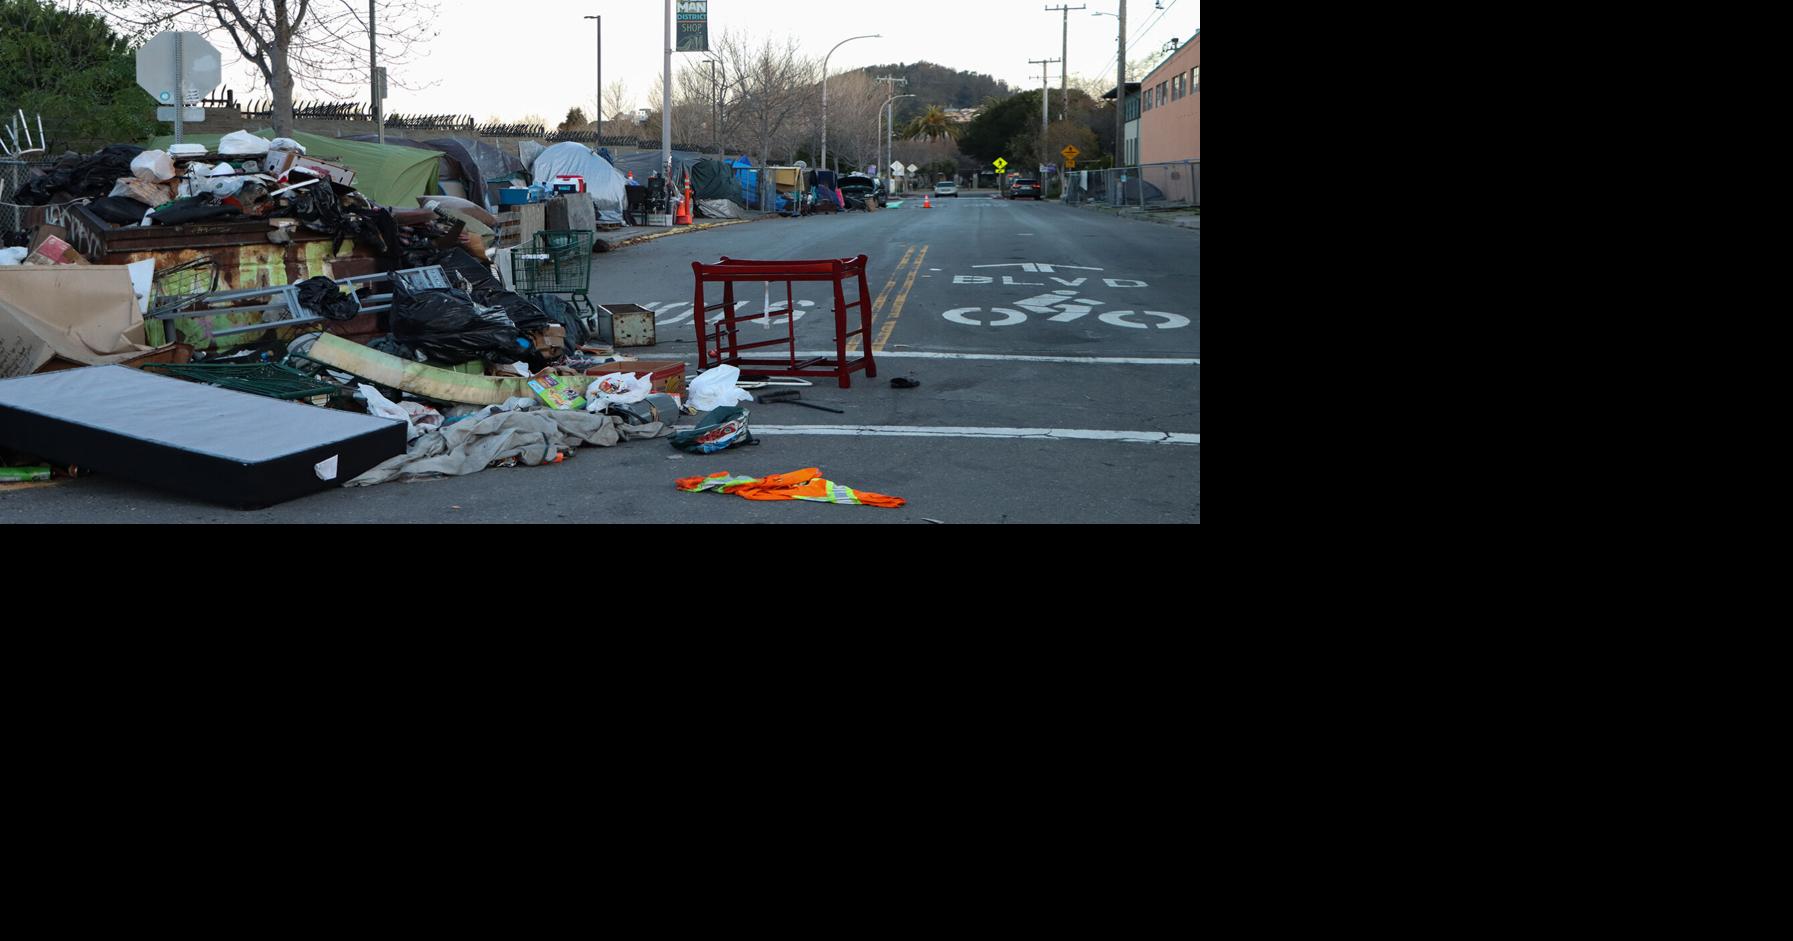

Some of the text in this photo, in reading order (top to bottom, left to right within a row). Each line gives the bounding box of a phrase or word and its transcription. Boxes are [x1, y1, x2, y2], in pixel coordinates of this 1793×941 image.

[677, 2, 706, 13] MAN
[681, 23, 702, 32] SHOP
[952, 275, 1149, 288] BLVD
[643, 300, 815, 326] STO
